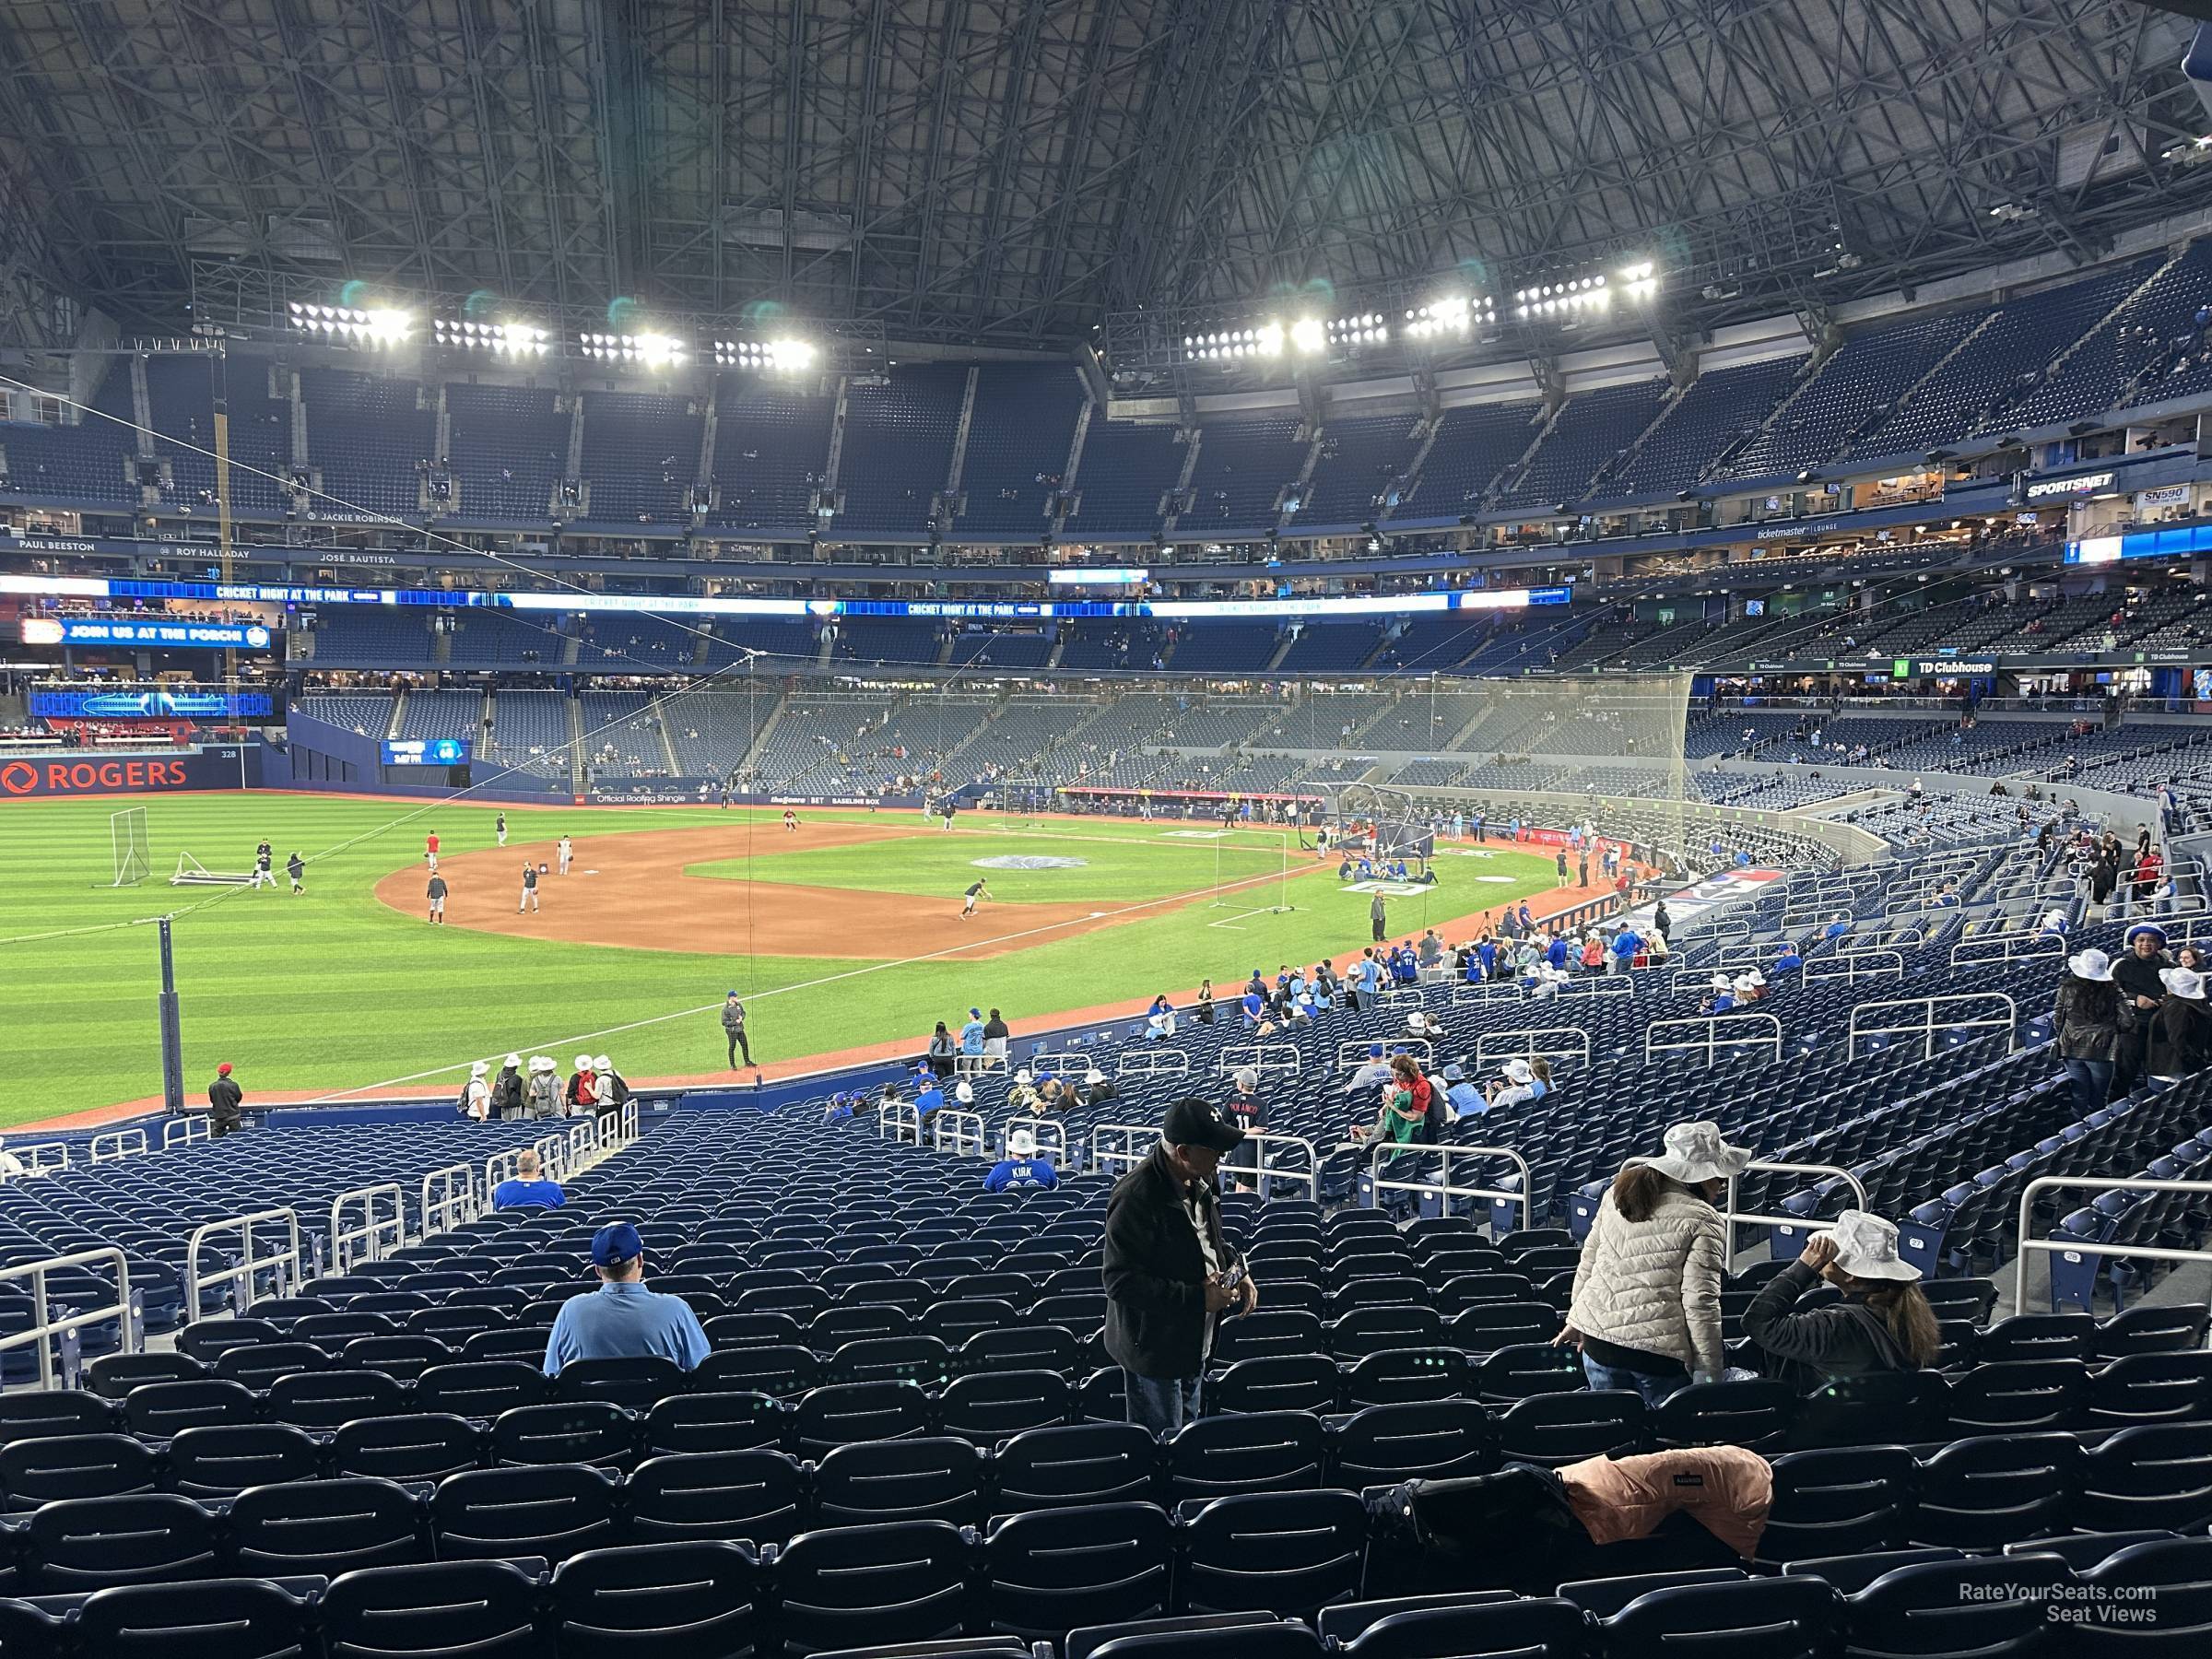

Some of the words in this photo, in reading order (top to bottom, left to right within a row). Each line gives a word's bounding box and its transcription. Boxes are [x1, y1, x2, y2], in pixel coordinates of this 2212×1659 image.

[2028, 473, 2113, 498] SPORTSNET
[2145, 488, 2183, 500] SN590
[322, 513, 353, 522] JACKIE
[355, 515, 403, 524] ROBINSON
[1758, 526, 1806, 538] ticketmaster
[1814, 524, 1838, 532] LOUNGE
[19, 540, 45, 549] PAUL
[48, 541, 95, 551] BEESTON
[176, 547, 196, 557] ROY
[199, 549, 250, 559] HALLADAY
[320, 553, 345, 562] JOSÉ
[350, 555, 395, 564] BAUTISTA
[216, 587, 257, 599] CRICKET
[260, 588, 289, 599] NIGHT
[290, 589, 302, 600] AT
[303, 590, 323, 600] THE
[324, 591, 349, 602] PARK
[908, 604, 940, 615] CRICKET
[942, 604, 965, 615] NIGHT
[966, 605, 976, 615] AT
[977, 605, 993, 615] THE
[994, 605, 1014, 615] PARK
[70, 626, 109, 639] JOIN
[112, 627, 134, 639] US
[137, 628, 157, 640] AT
[159, 628, 186, 640] THE
[1919, 663, 1934, 673] TD
[1935, 662, 1993, 673] Clubhouse
[48, 760, 186, 789] ROGERS
[596, 794, 625, 803] Official
[657, 794, 686, 803] Shingle
[1230, 1102, 1258, 1114] POLANCO
[1236, 1114, 1249, 1129] 11
[1011, 1167, 1032, 1178] KIRK
